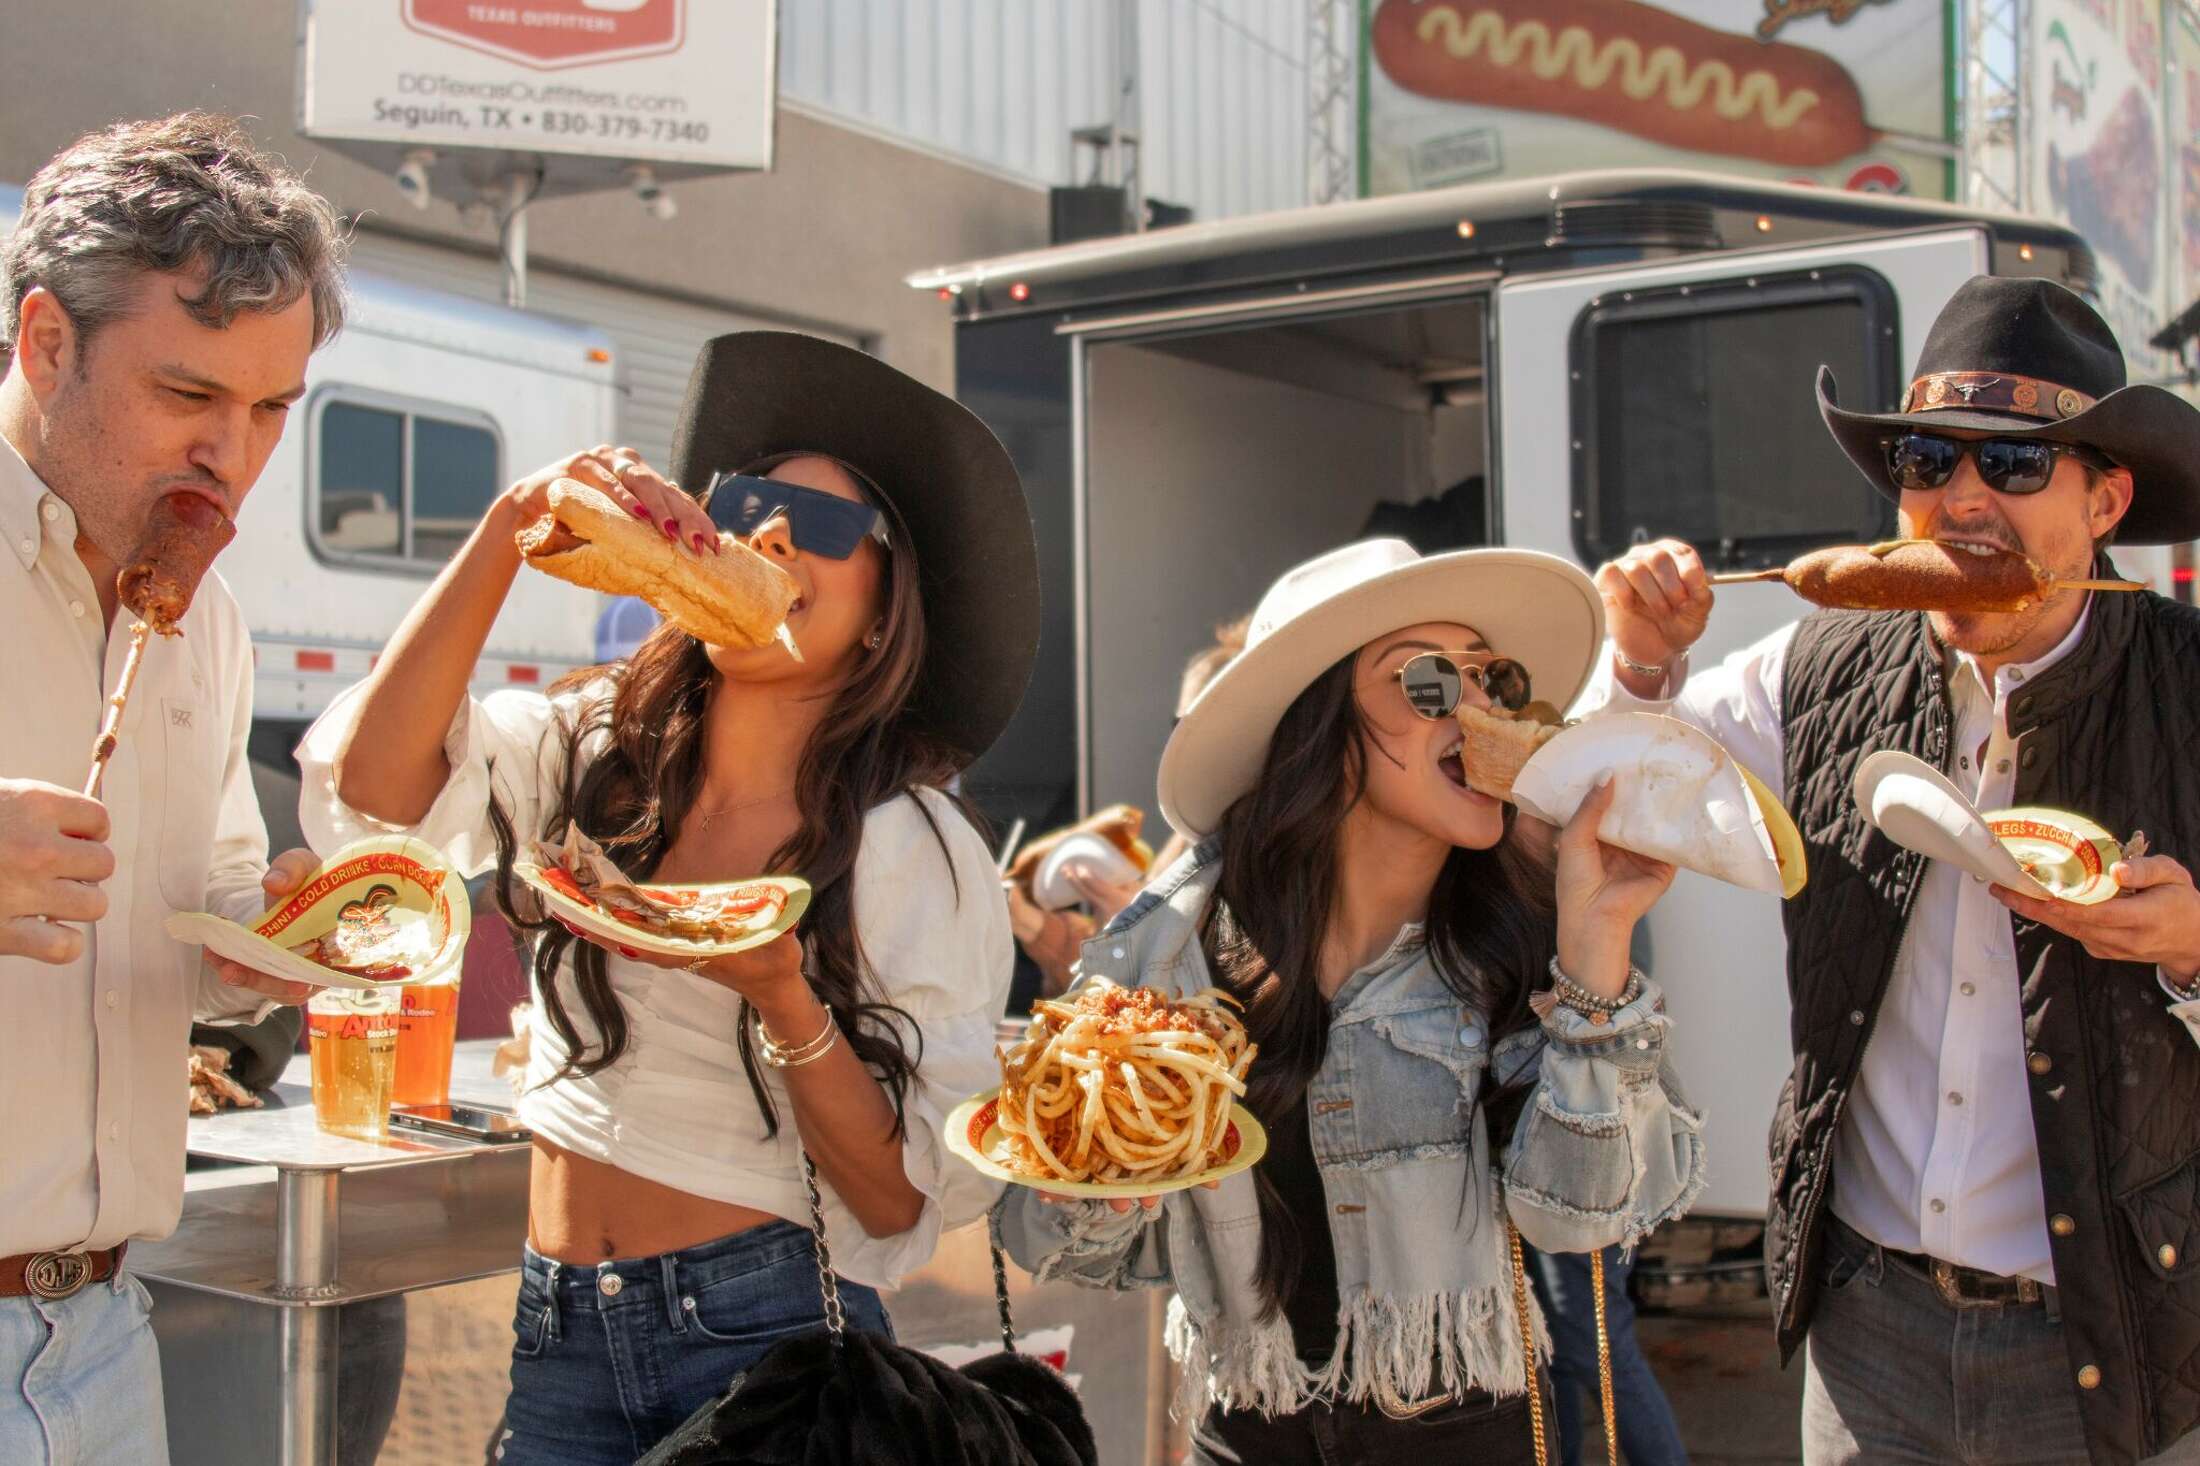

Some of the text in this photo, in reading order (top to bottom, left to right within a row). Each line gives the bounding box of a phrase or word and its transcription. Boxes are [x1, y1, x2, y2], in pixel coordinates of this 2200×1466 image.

[467, 4, 617, 33] TEXAS OUTFITTERS
[373, 96, 709, 143] Seguin, TX 830-379-7340
[1994, 823, 2026, 836] LEGS
[297, 879, 330, 909] COLD
[330, 858, 371, 887] DRINKS
